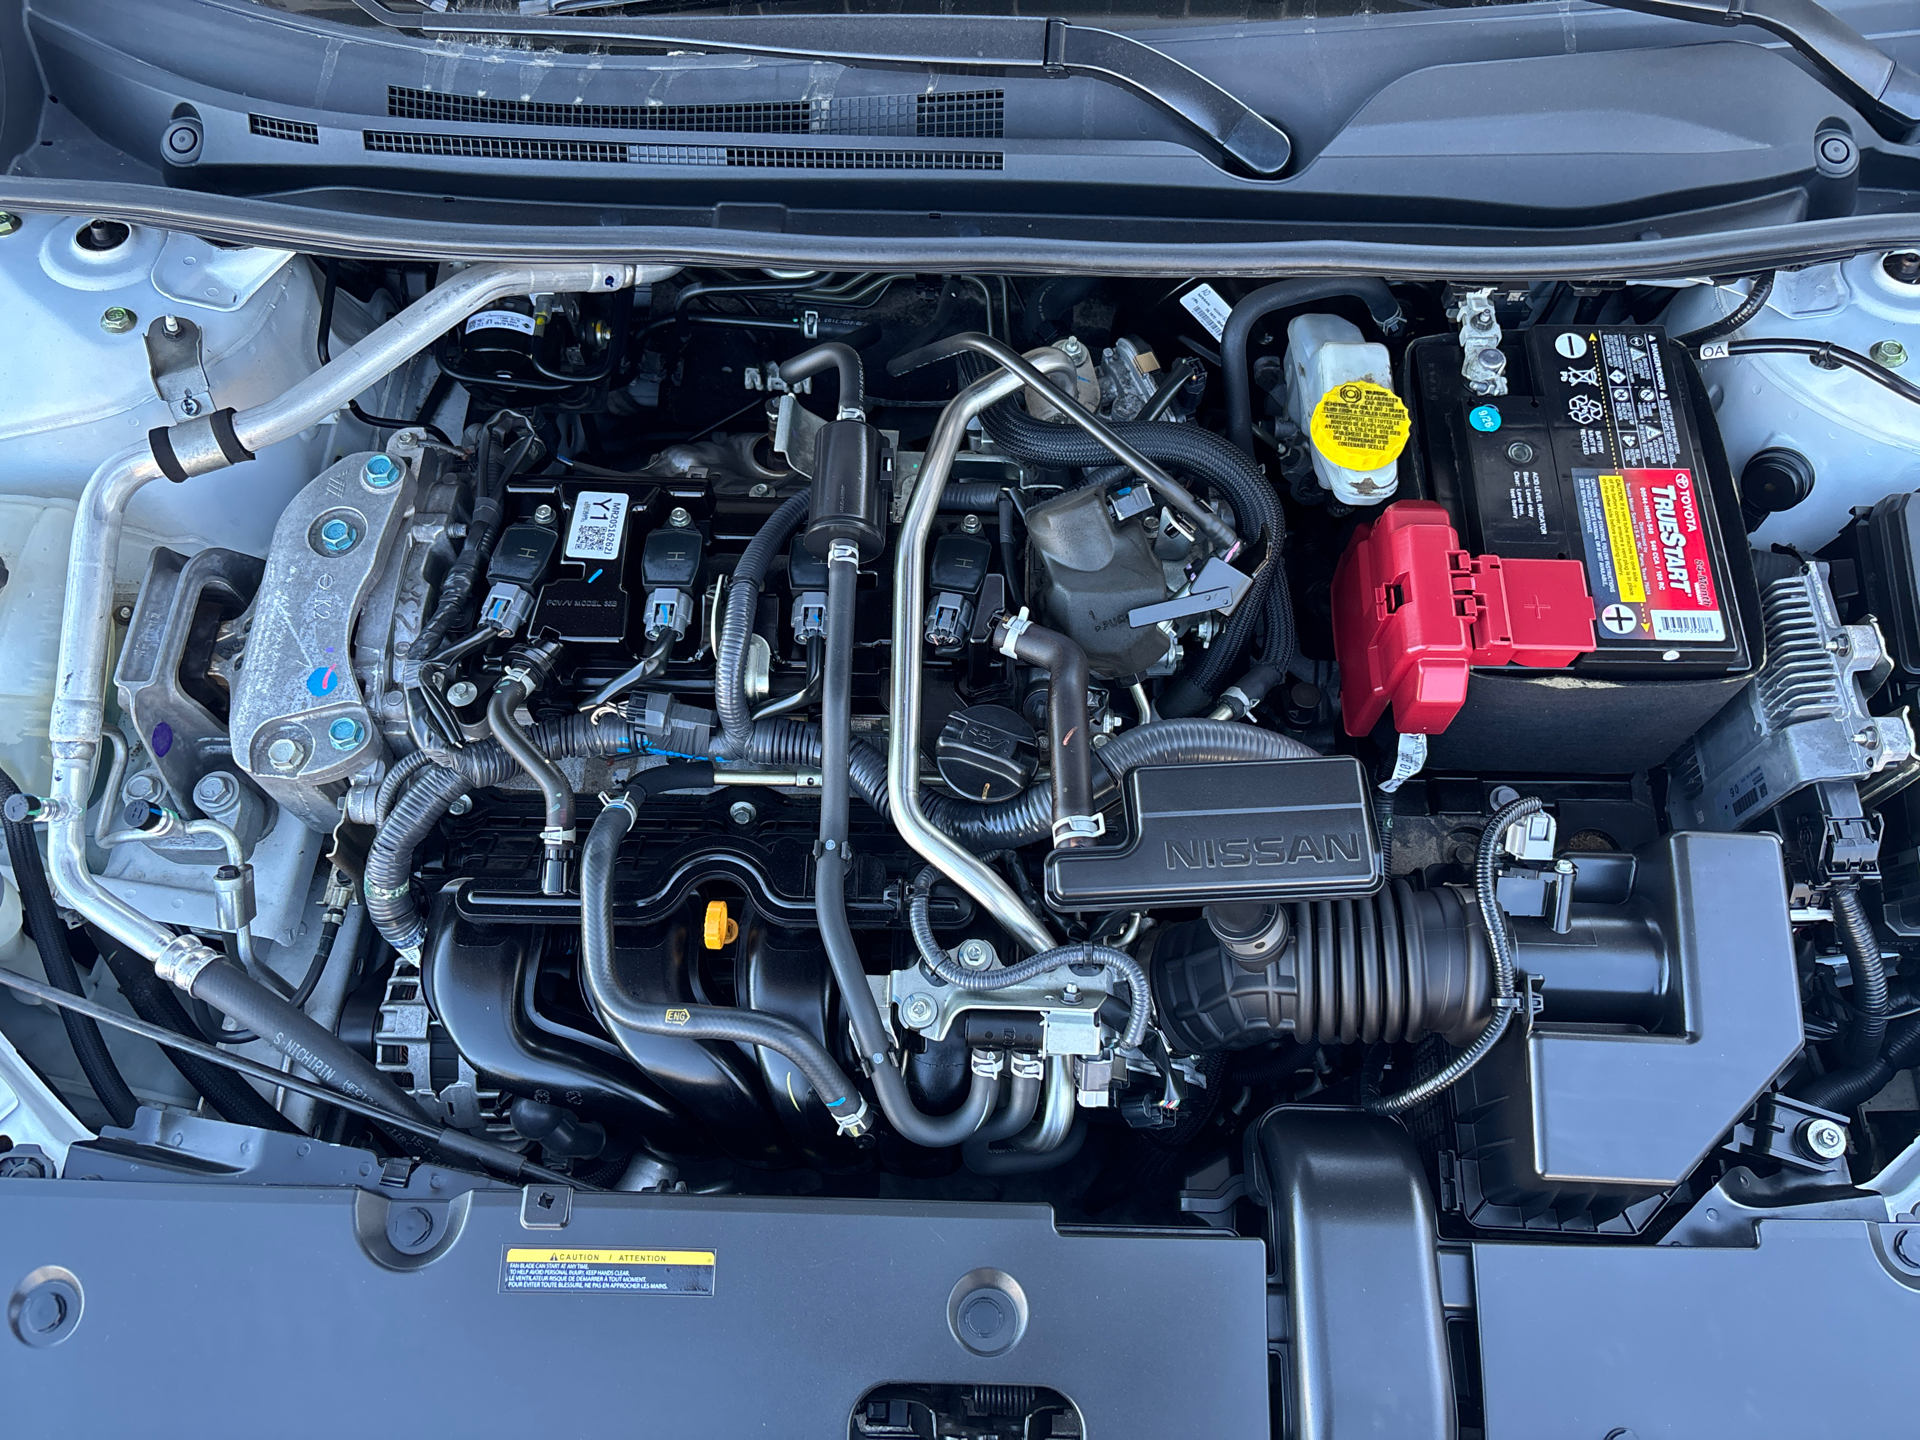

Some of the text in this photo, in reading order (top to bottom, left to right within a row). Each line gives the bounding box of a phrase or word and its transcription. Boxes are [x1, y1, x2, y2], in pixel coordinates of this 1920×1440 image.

[1703, 346, 1725, 357] OA
[1559, 370, 1568, 381] Pb
[1650, 343, 1666, 390] DANGER/POISON
[1478, 409, 1494, 428] 9/26
[1579, 428, 1589, 455] RECYCLED
[1586, 430, 1595, 445] MUST
[1594, 430, 1604, 453] BATTERY
[1513, 471, 1521, 486] Clear:
[1515, 488, 1524, 502] Level
[1522, 471, 1535, 517] Black: Level okay
[1531, 471, 1547, 534] ACID LEVEL INDICATOR
[1510, 499, 1518, 518] battery
[1610, 493, 1618, 509] battery
[1616, 526, 1624, 542] ensure
[1614, 478, 1623, 500] CAUTION:
[1624, 534, 1633, 554] attaches
[1680, 490, 1696, 532] TOYOTA
[1637, 521, 1647, 545] Distributed
[1612, 535, 1620, 557] installing
[1649, 540, 1657, 550] 540
[1652, 551, 1660, 564] CCA
[1655, 570, 1663, 580] 100
[1657, 581, 1665, 590] RC
[1696, 560, 1712, 606] 84-Month
[314, 598, 331, 619] K2
[1164, 832, 1361, 870] NISSAN
[668, 1012, 686, 1020] ENG
